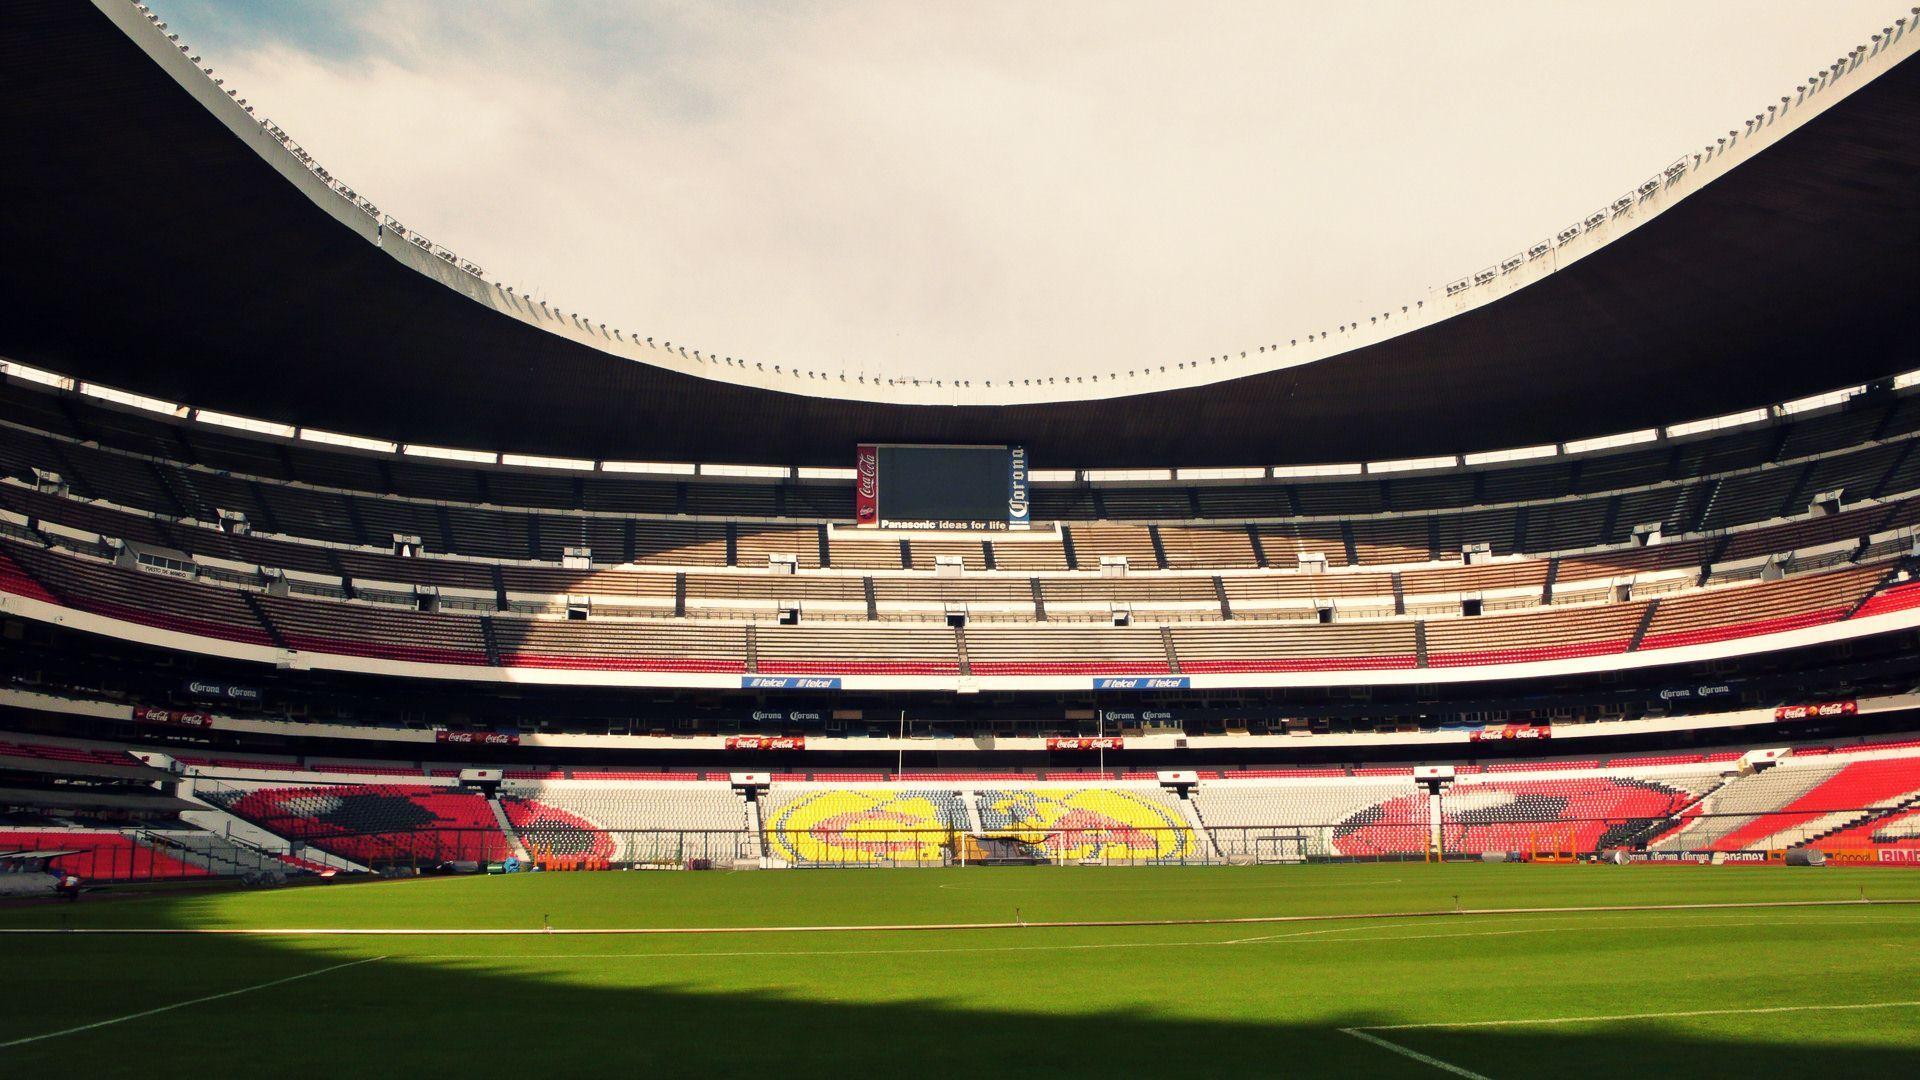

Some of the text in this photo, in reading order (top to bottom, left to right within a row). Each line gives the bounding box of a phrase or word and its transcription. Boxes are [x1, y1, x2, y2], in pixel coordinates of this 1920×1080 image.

[1009, 447, 1030, 518] Corona
[881, 520, 1006, 530] Panasonic ideas for life
[760, 679, 832, 688] telcel telcel
[1111, 678, 1182, 688] telcel telcel
[189, 681, 257, 697] Corona Corona
[1660, 685, 1729, 700] Corona Corona
[752, 711, 819, 721] Corona Corona
[1105, 711, 1171, 721] Corona Corona
[1724, 852, 1765, 861] anamex
